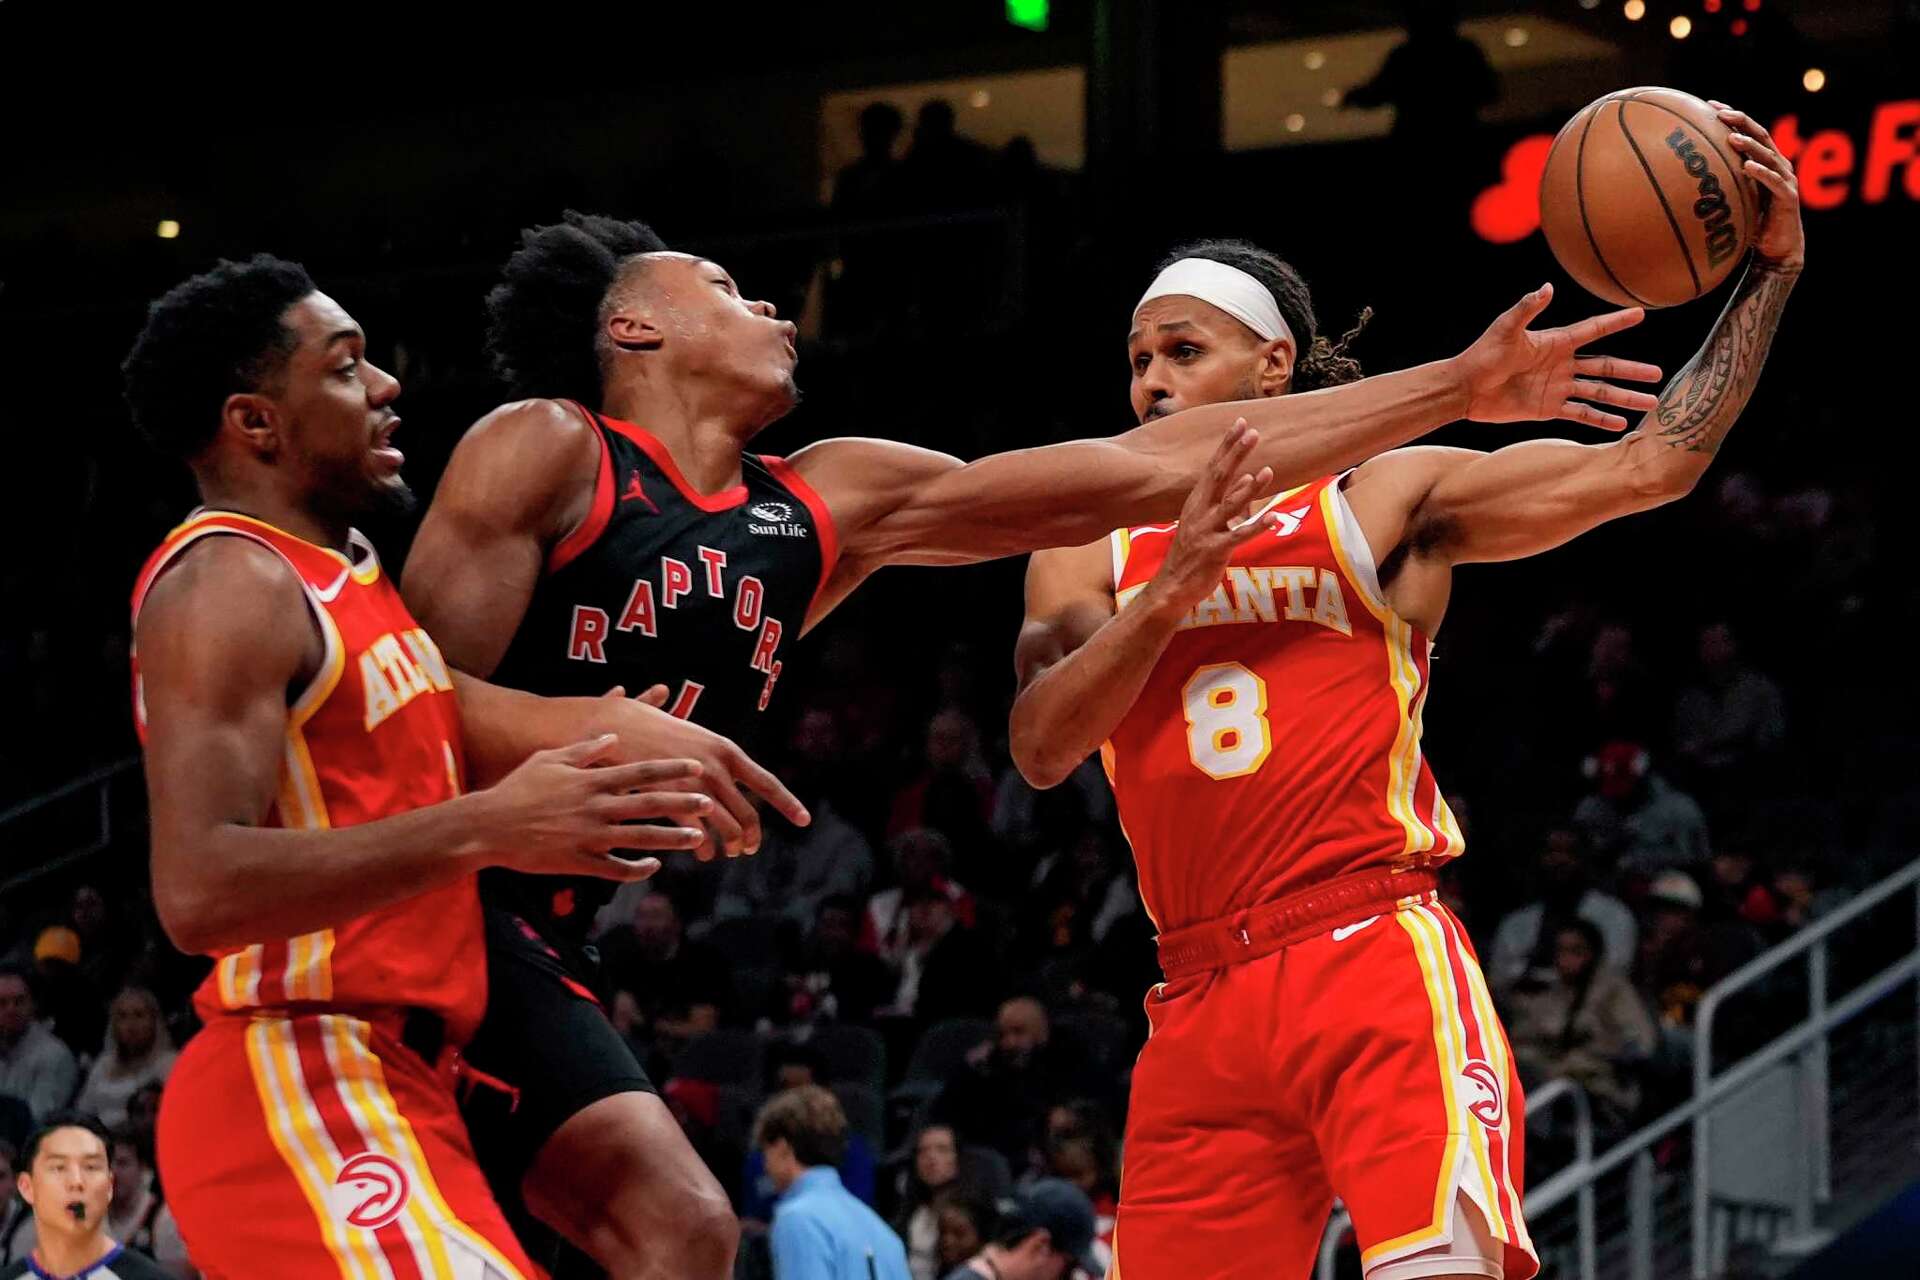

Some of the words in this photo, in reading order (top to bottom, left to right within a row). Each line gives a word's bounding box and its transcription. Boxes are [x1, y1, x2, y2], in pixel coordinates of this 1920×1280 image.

[748, 523, 779, 535] Sun
[780, 523, 808, 538] Life
[1115, 566, 1353, 638] ANTA
[1182, 661, 1272, 781] 8
